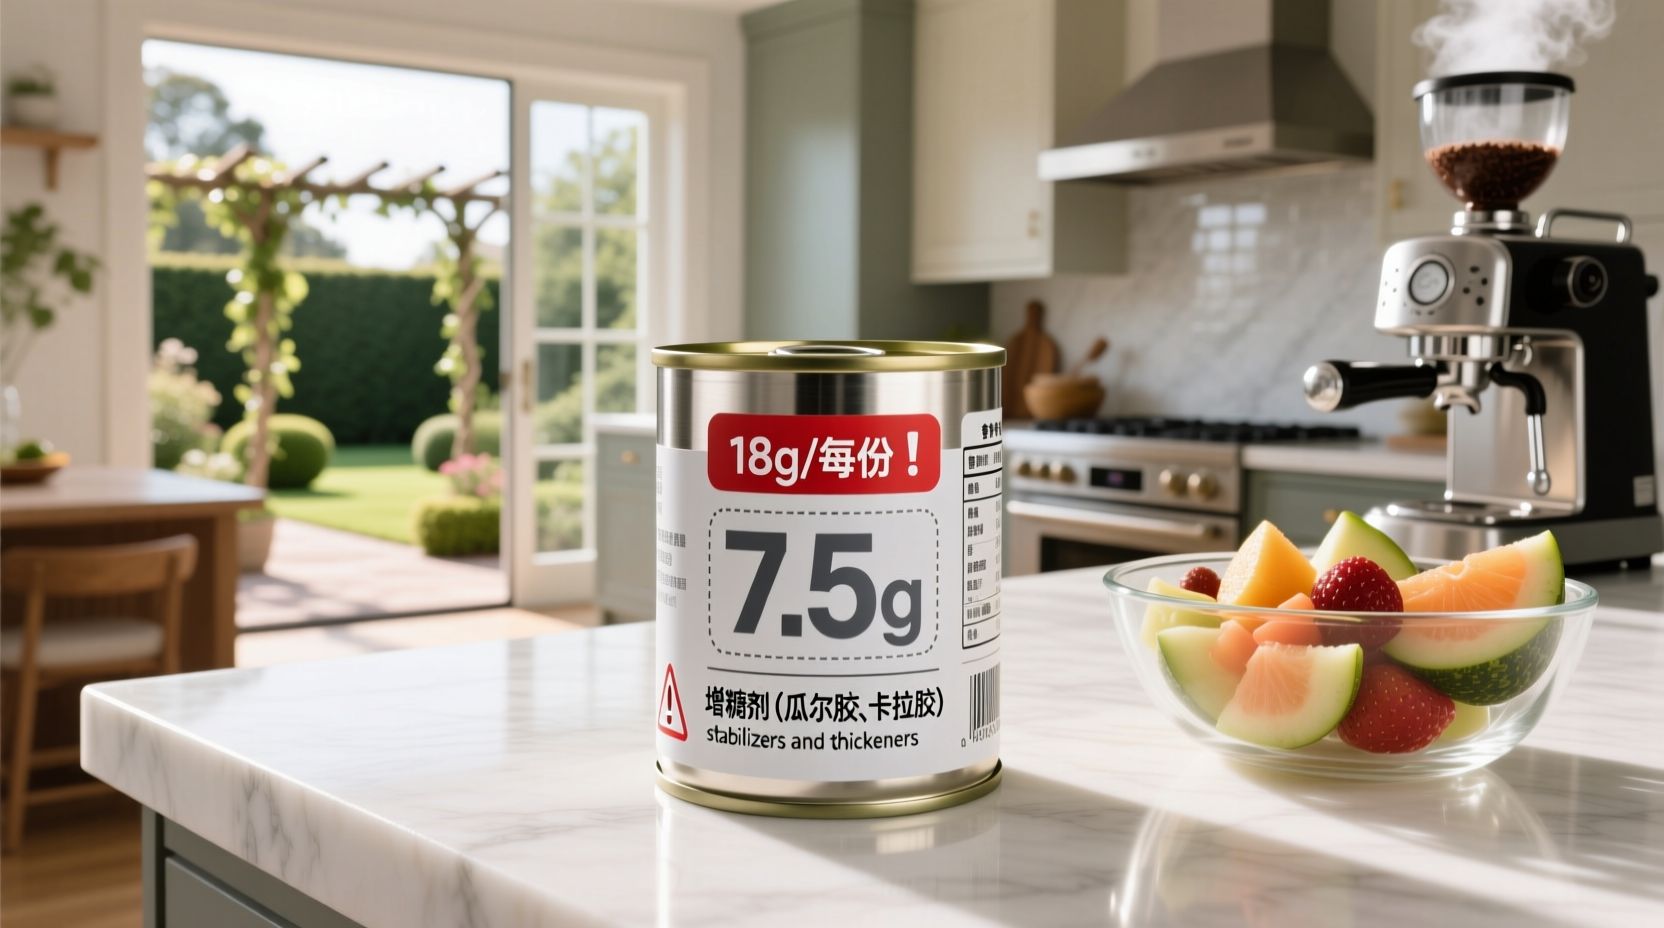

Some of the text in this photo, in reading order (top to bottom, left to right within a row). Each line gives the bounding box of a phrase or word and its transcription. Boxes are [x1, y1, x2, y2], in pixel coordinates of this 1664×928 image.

[725, 529, 922, 647] 7.5g
[706, 725, 919, 751] stabilizers and thickeners
